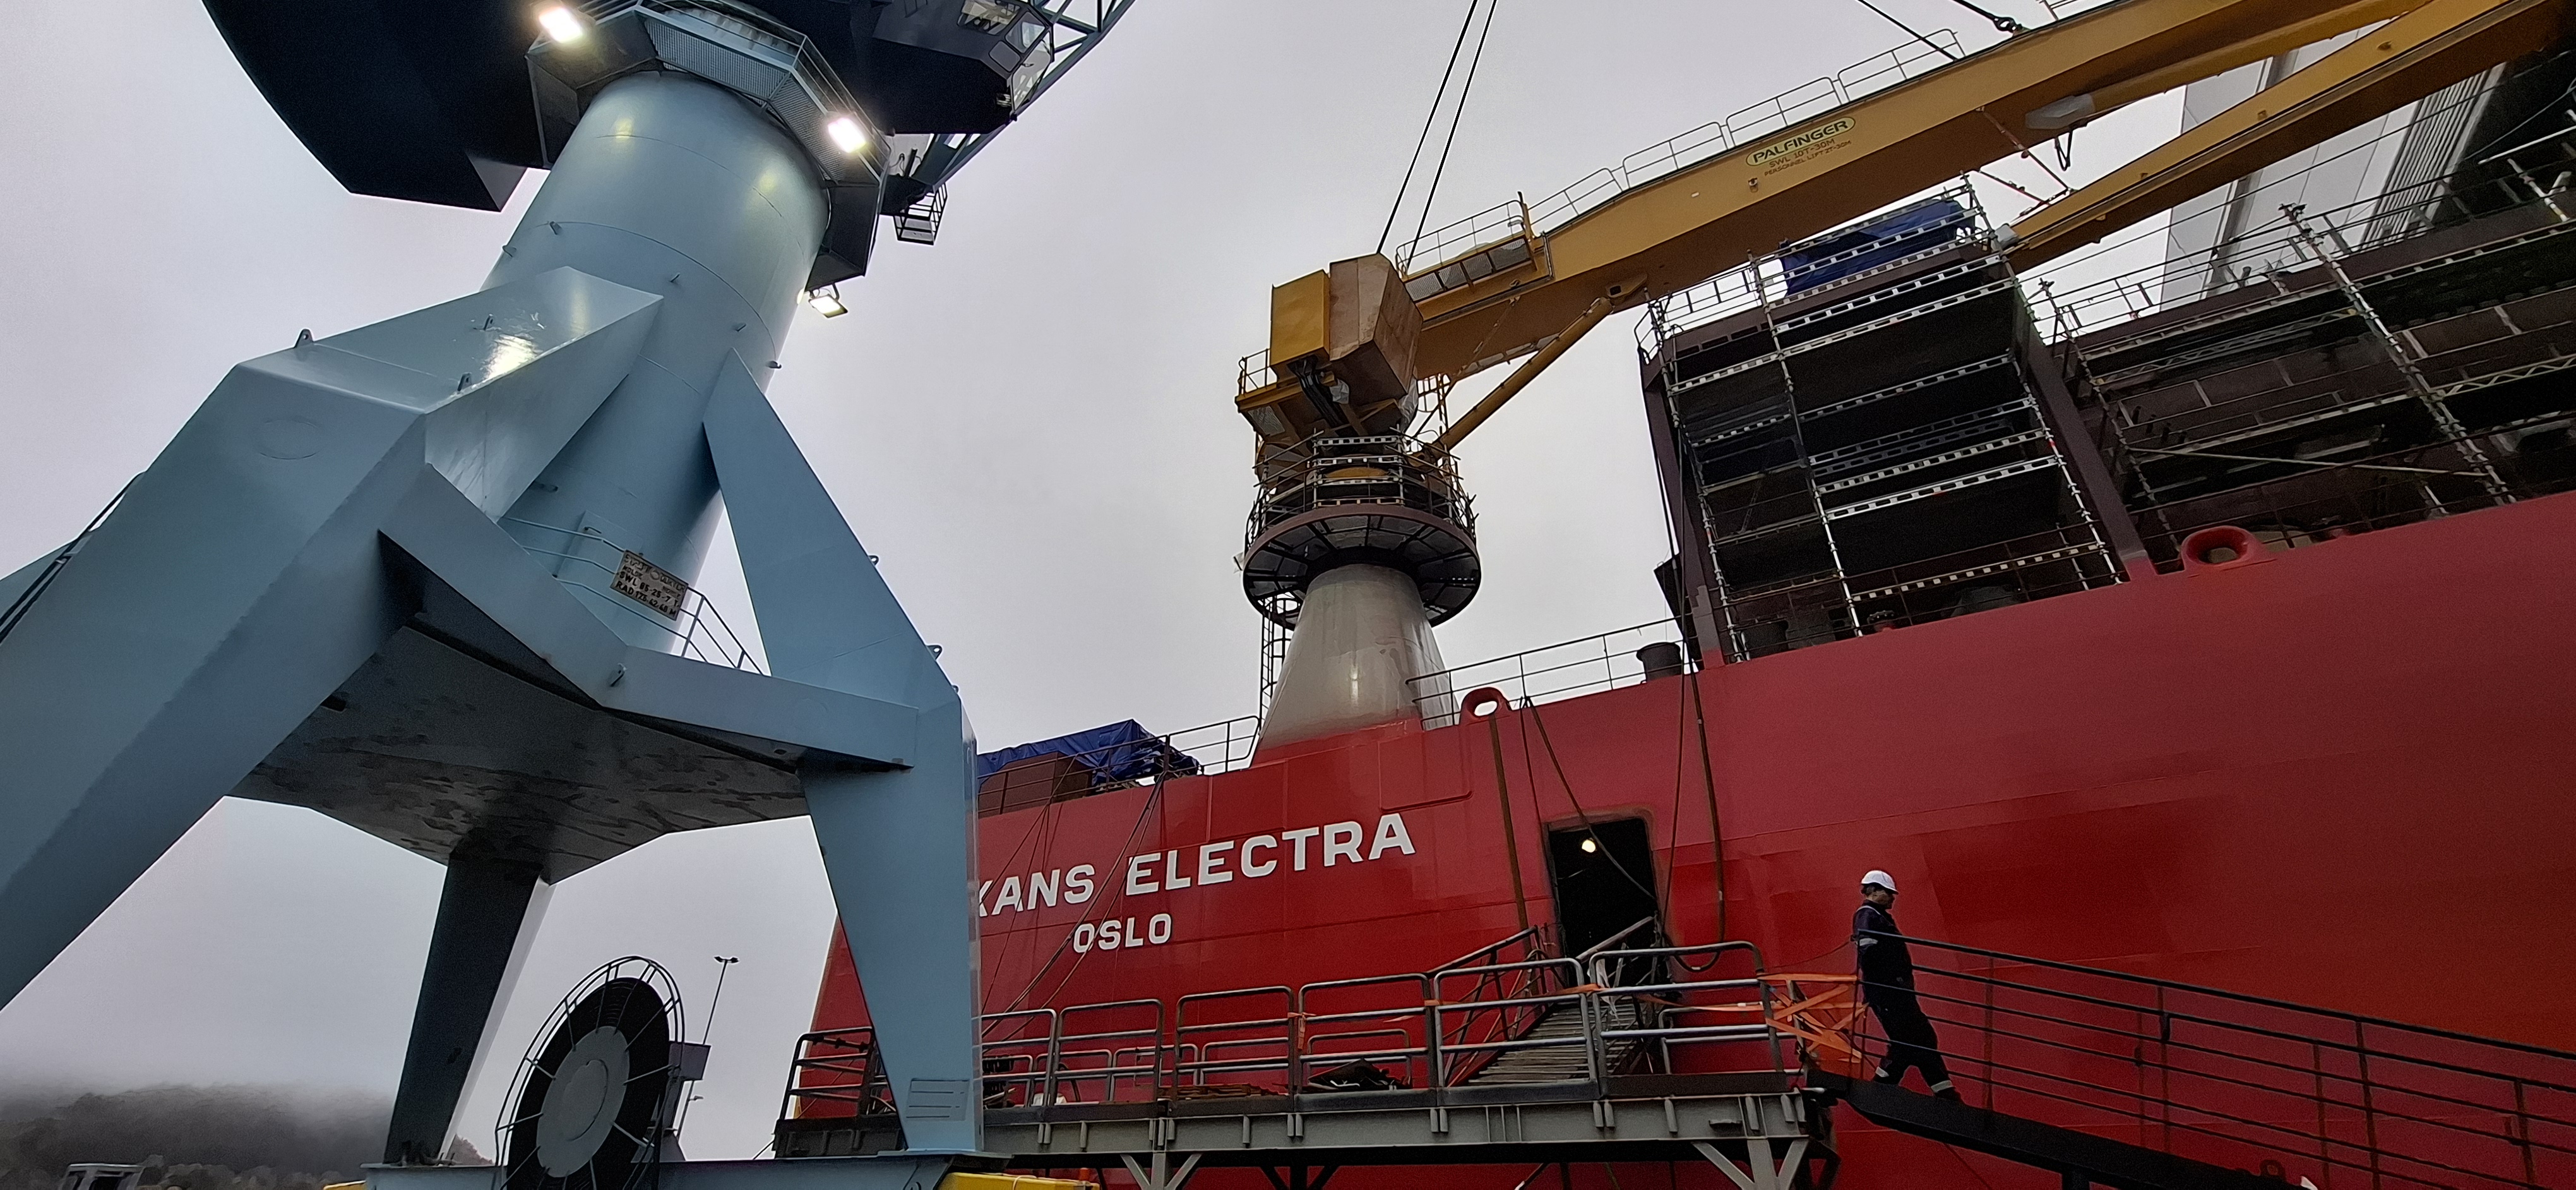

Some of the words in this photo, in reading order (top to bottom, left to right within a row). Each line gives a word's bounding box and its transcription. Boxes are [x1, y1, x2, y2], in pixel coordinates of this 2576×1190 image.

[1753, 120, 1849, 163] PALFINGER
[1769, 155, 1791, 168] SWL
[1794, 138, 1835, 159] 10T-30M
[616, 580, 634, 594] RAD
[619, 571, 637, 586] SWL
[1125, 812, 1416, 896] ELECTRA
[1073, 913, 1172, 954] OSLO
